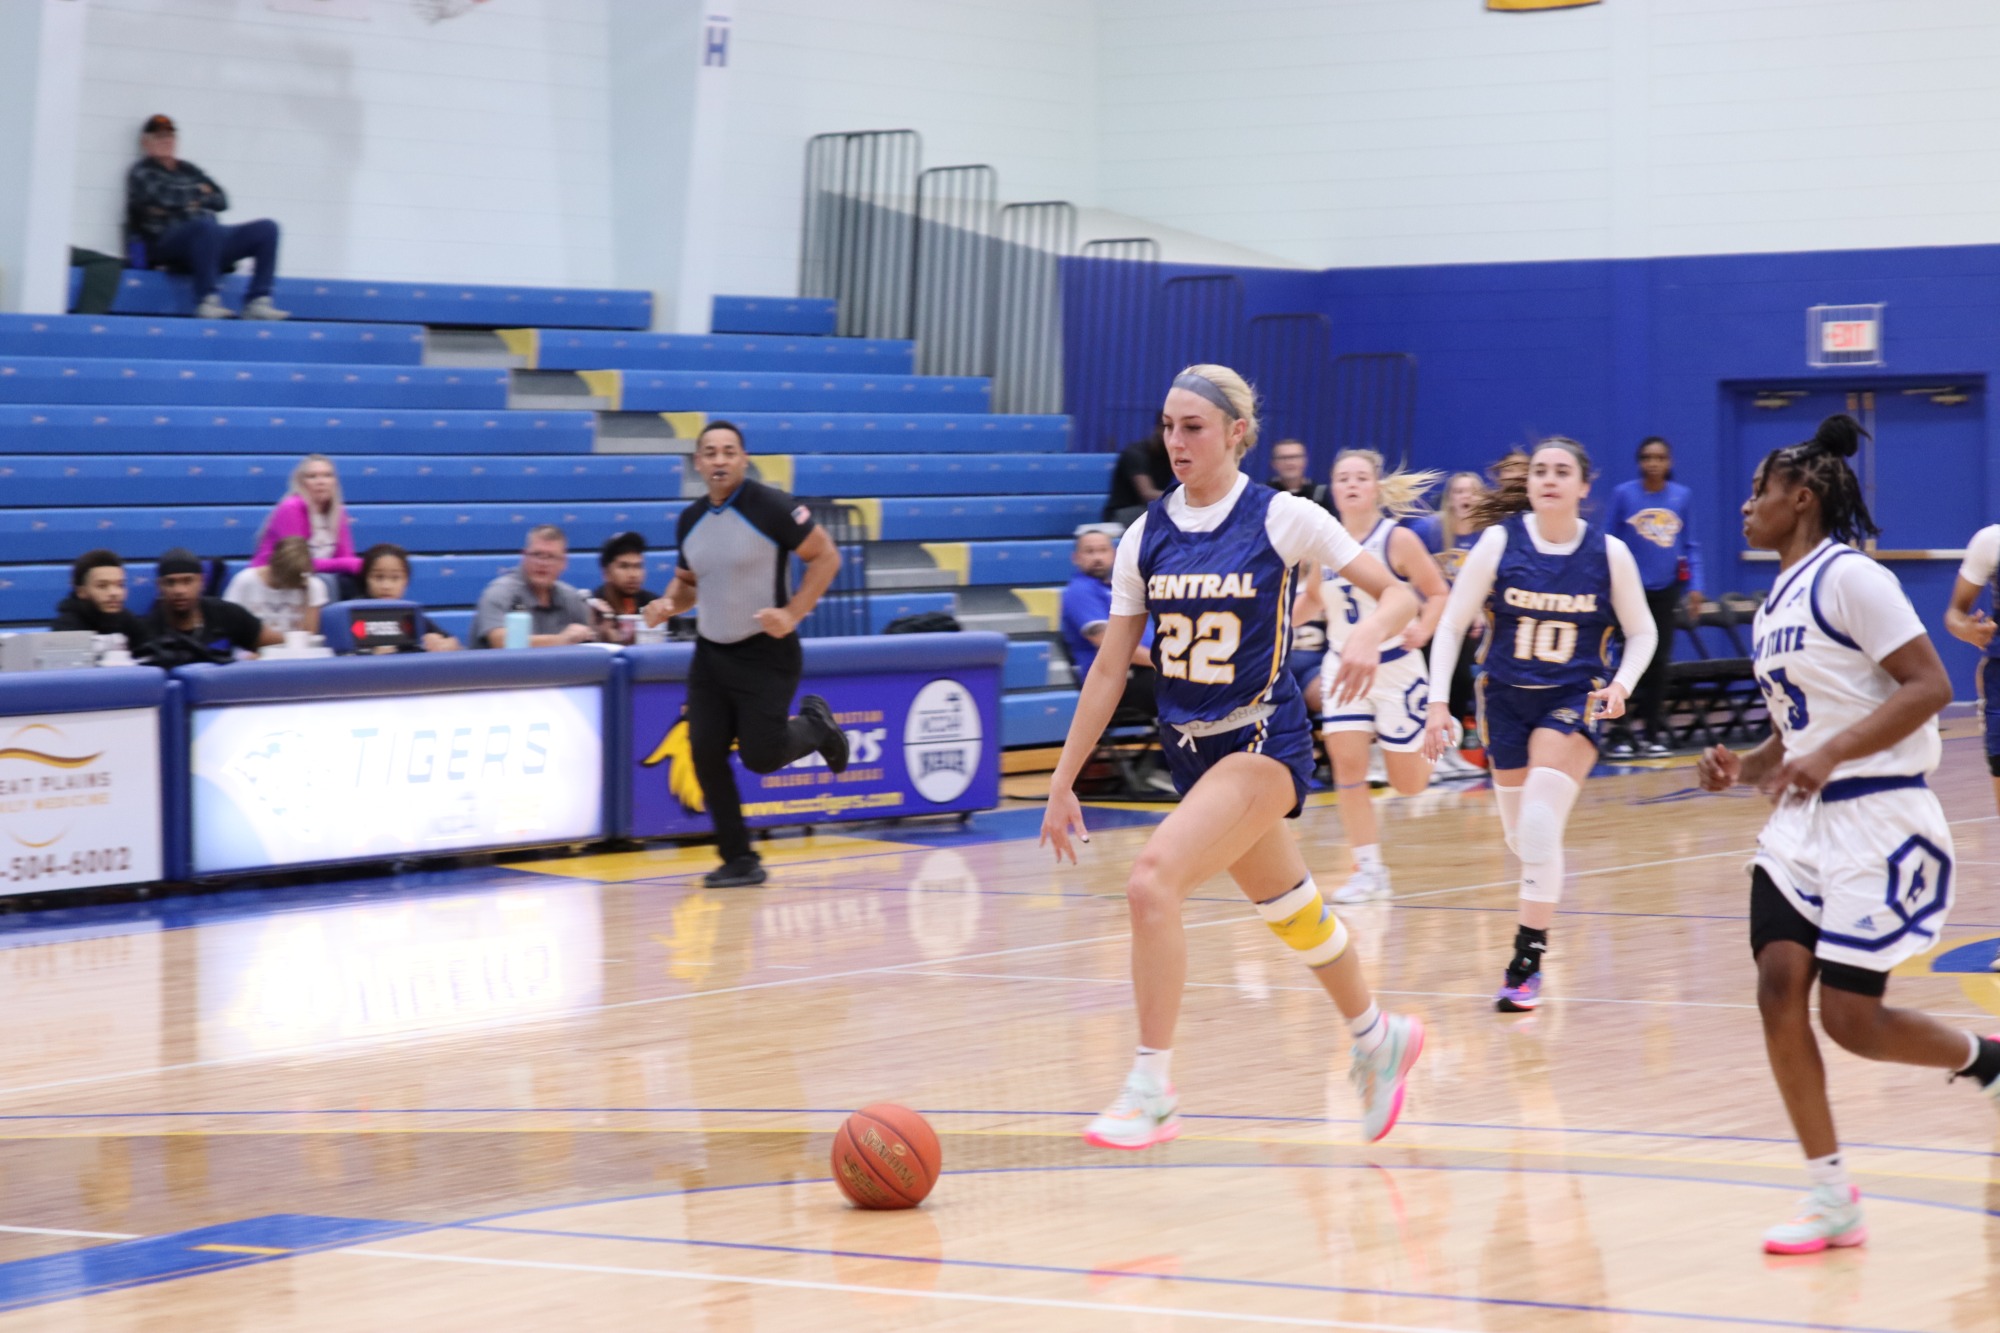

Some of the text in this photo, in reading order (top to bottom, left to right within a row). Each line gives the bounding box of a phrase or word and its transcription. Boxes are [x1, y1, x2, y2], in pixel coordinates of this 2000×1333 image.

[1148, 572, 1257, 600] CENTRAL
[1504, 587, 1598, 613] CENTRAL
[1157, 610, 1242, 685] 22
[1513, 616, 1579, 664] 10
[1765, 625, 1807, 658] STATE
[350, 721, 552, 788] TIGERS
[39, 771, 111, 792] PLAINS
[860, 1128, 915, 1189] SPALDING
